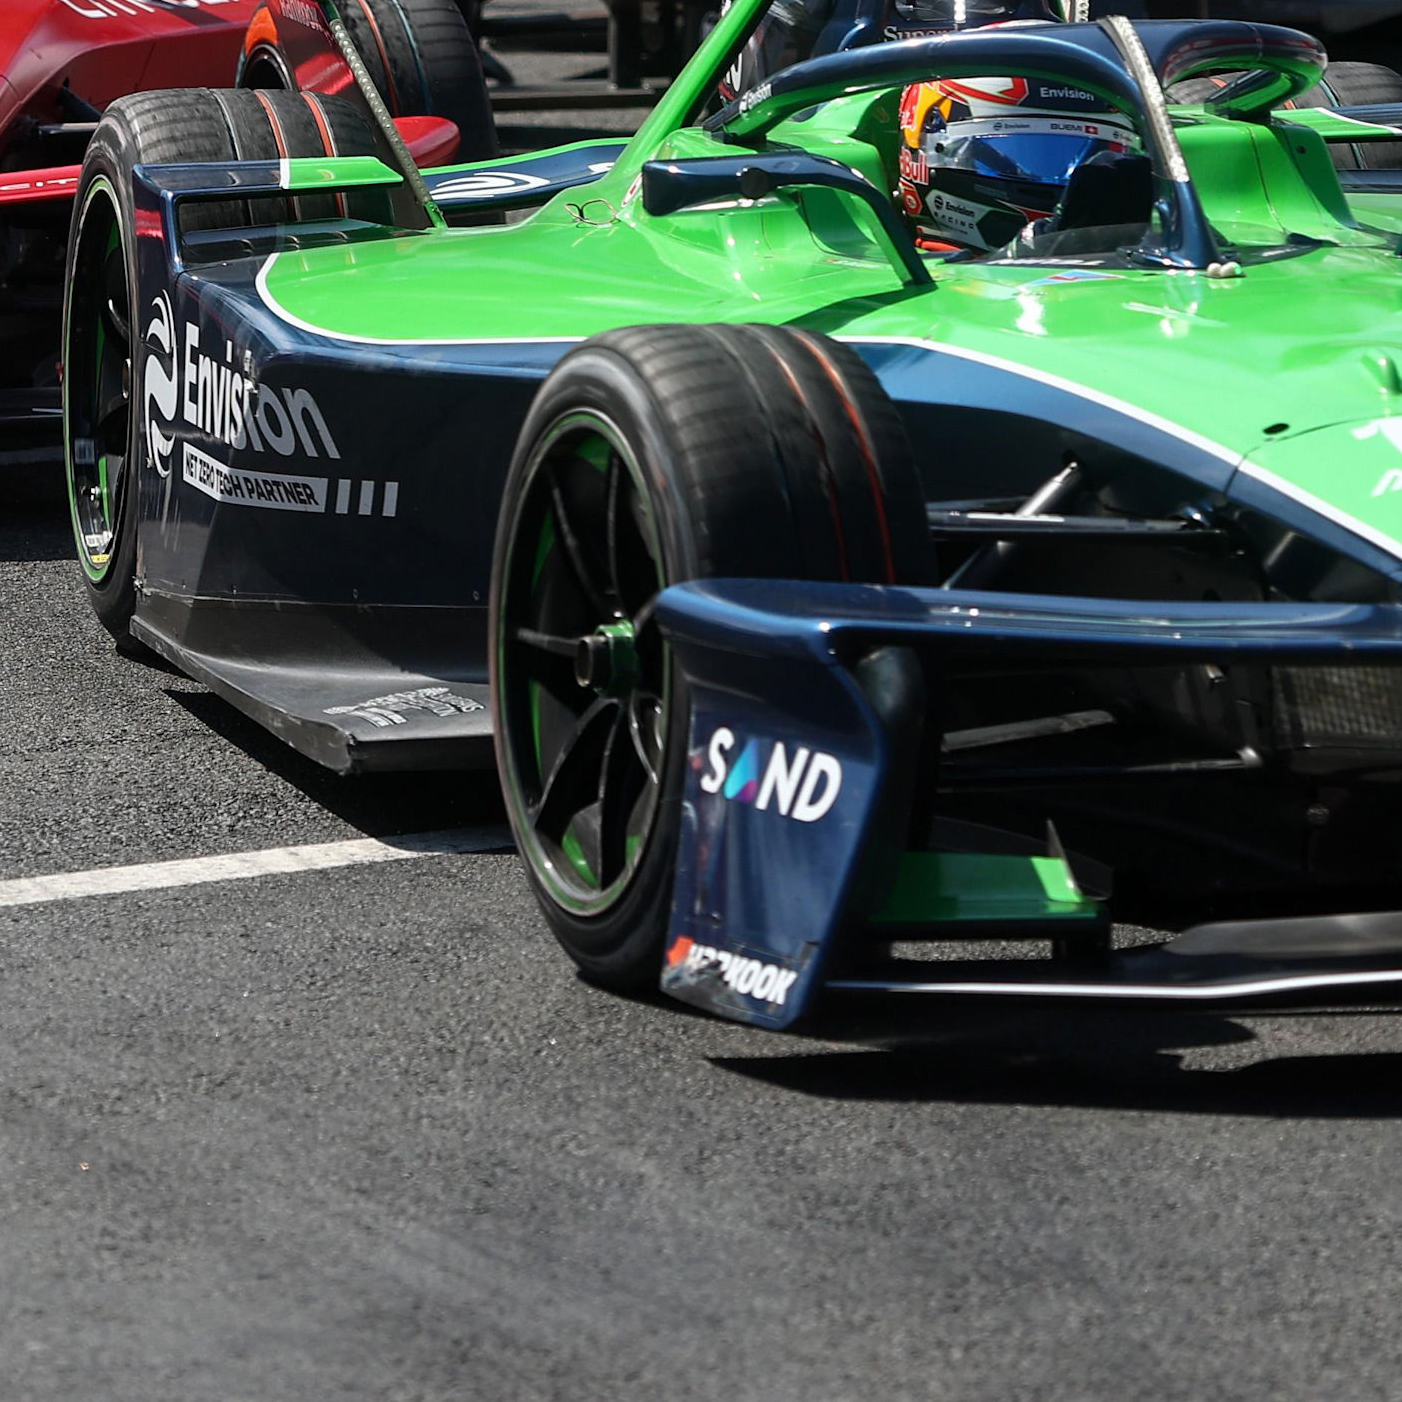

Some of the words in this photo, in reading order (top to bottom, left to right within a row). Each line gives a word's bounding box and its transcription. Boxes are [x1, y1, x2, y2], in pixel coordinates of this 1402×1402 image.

[1040, 86, 1095, 102] Envision
[183, 322, 342, 460] Envision
[185, 451, 198, 478] NET
[199, 459, 215, 488] ZERO
[215, 467, 244, 499] TECH
[243, 475, 320, 507] PARTNER
